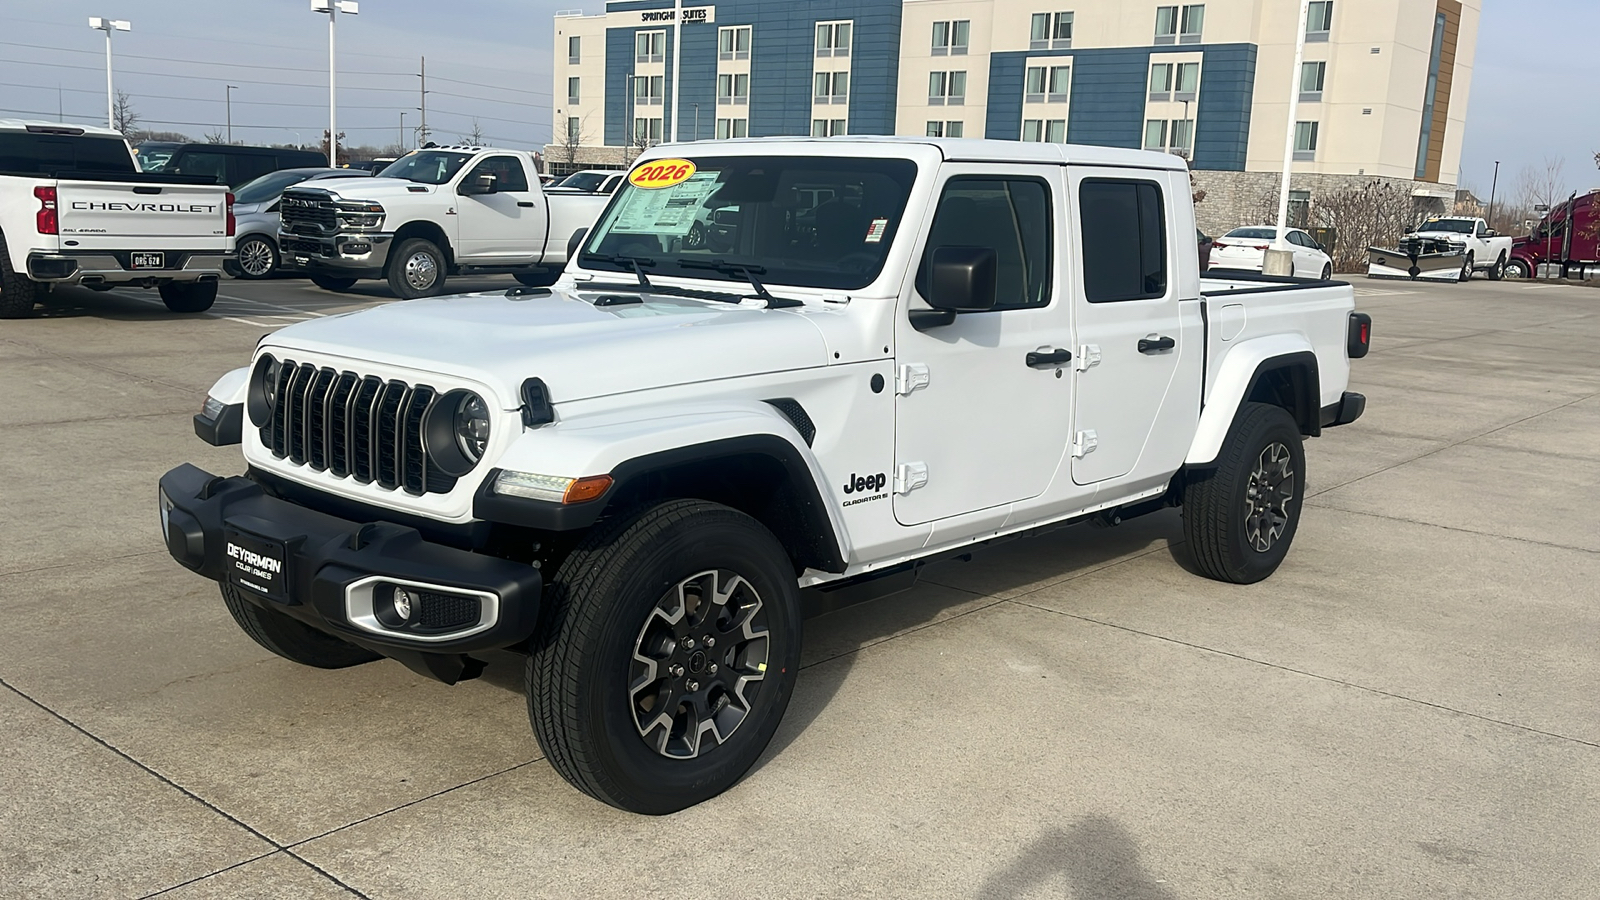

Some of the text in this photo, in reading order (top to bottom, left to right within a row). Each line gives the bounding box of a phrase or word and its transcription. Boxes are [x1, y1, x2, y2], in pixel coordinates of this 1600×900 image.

[641, 11, 681, 22] SPRINGHI
[682, 9, 707, 19] SUITES
[634, 164, 690, 182] 2026
[72, 201, 217, 213] CHEVROLET
[843, 472, 887, 494] Jeep
[842, 494, 882, 507] GLADIATOR
[226, 542, 282, 574] DEYARMAN
[252, 568, 273, 580] AMES
